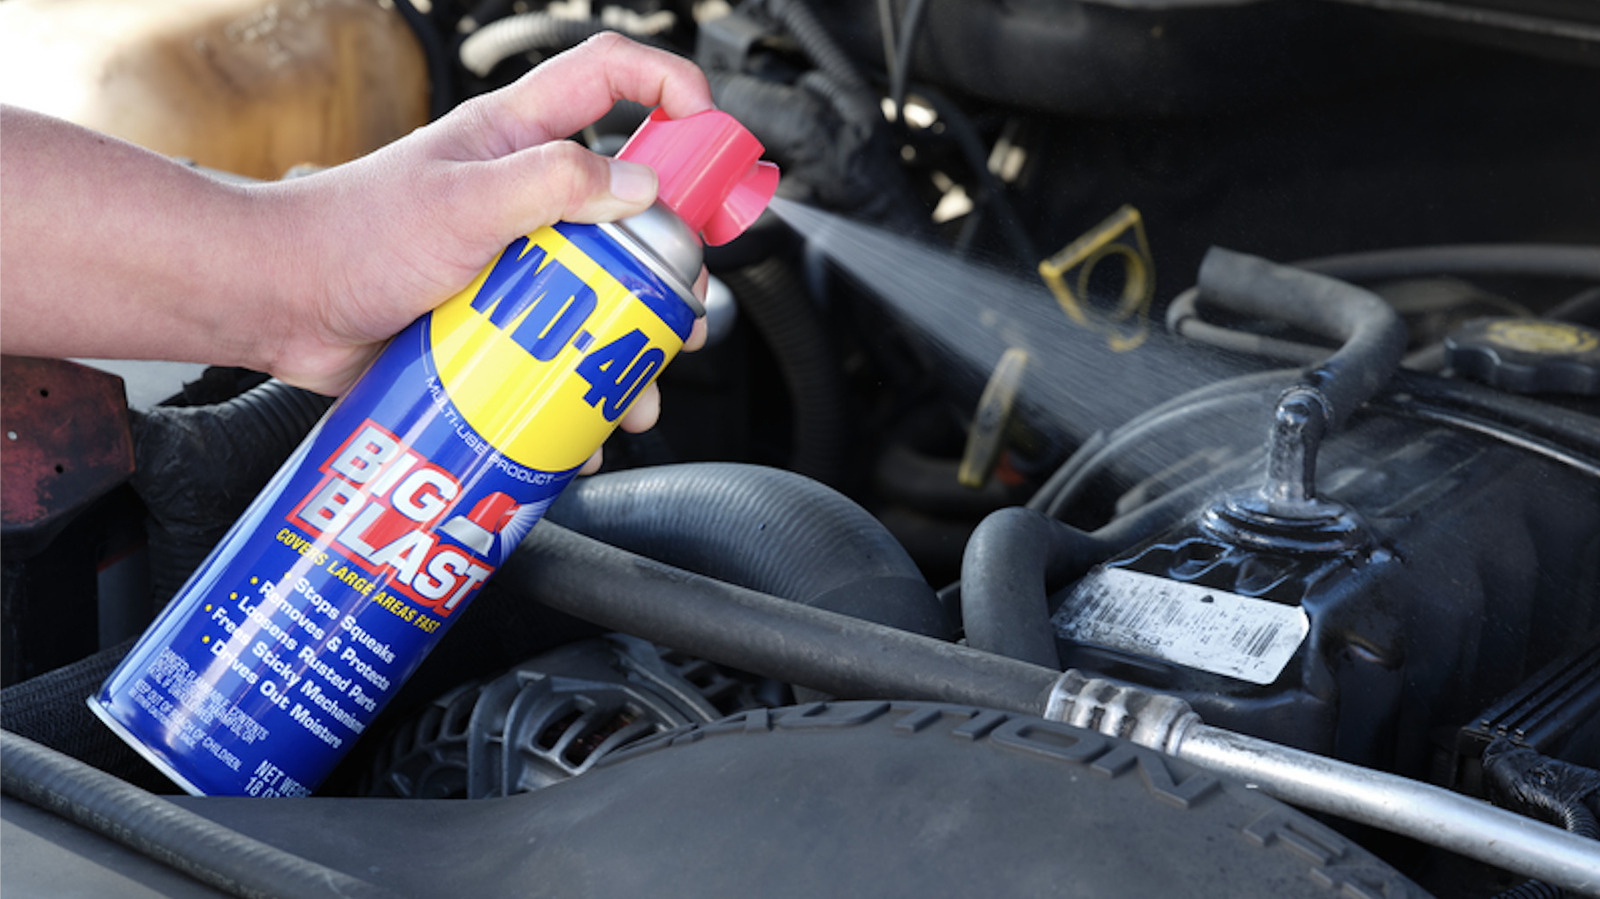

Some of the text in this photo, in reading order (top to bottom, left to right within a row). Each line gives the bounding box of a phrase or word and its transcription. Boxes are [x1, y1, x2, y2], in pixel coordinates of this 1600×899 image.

[470, 236, 665, 422] WD-40
[330, 425, 459, 523] BIG
[425, 376, 554, 485] MULTI-USE PRODUCT
[276, 528, 441, 634] COVERS LARGE AREAS FAST
[297, 475, 491, 611] BLAST
[211, 607, 252, 645] Frees
[252, 641, 302, 687] Sticky
[238, 596, 378, 712] Loosens Rusted Parts
[258, 580, 391, 691] Removes & Protects
[294, 577, 396, 665] Stops Squeaks
[210, 639, 260, 685] Drives
[259, 680, 291, 710] Out
[290, 703, 343, 749] Moisture
[244, 776, 264, 798] 18
[254, 759, 285, 787] NET
